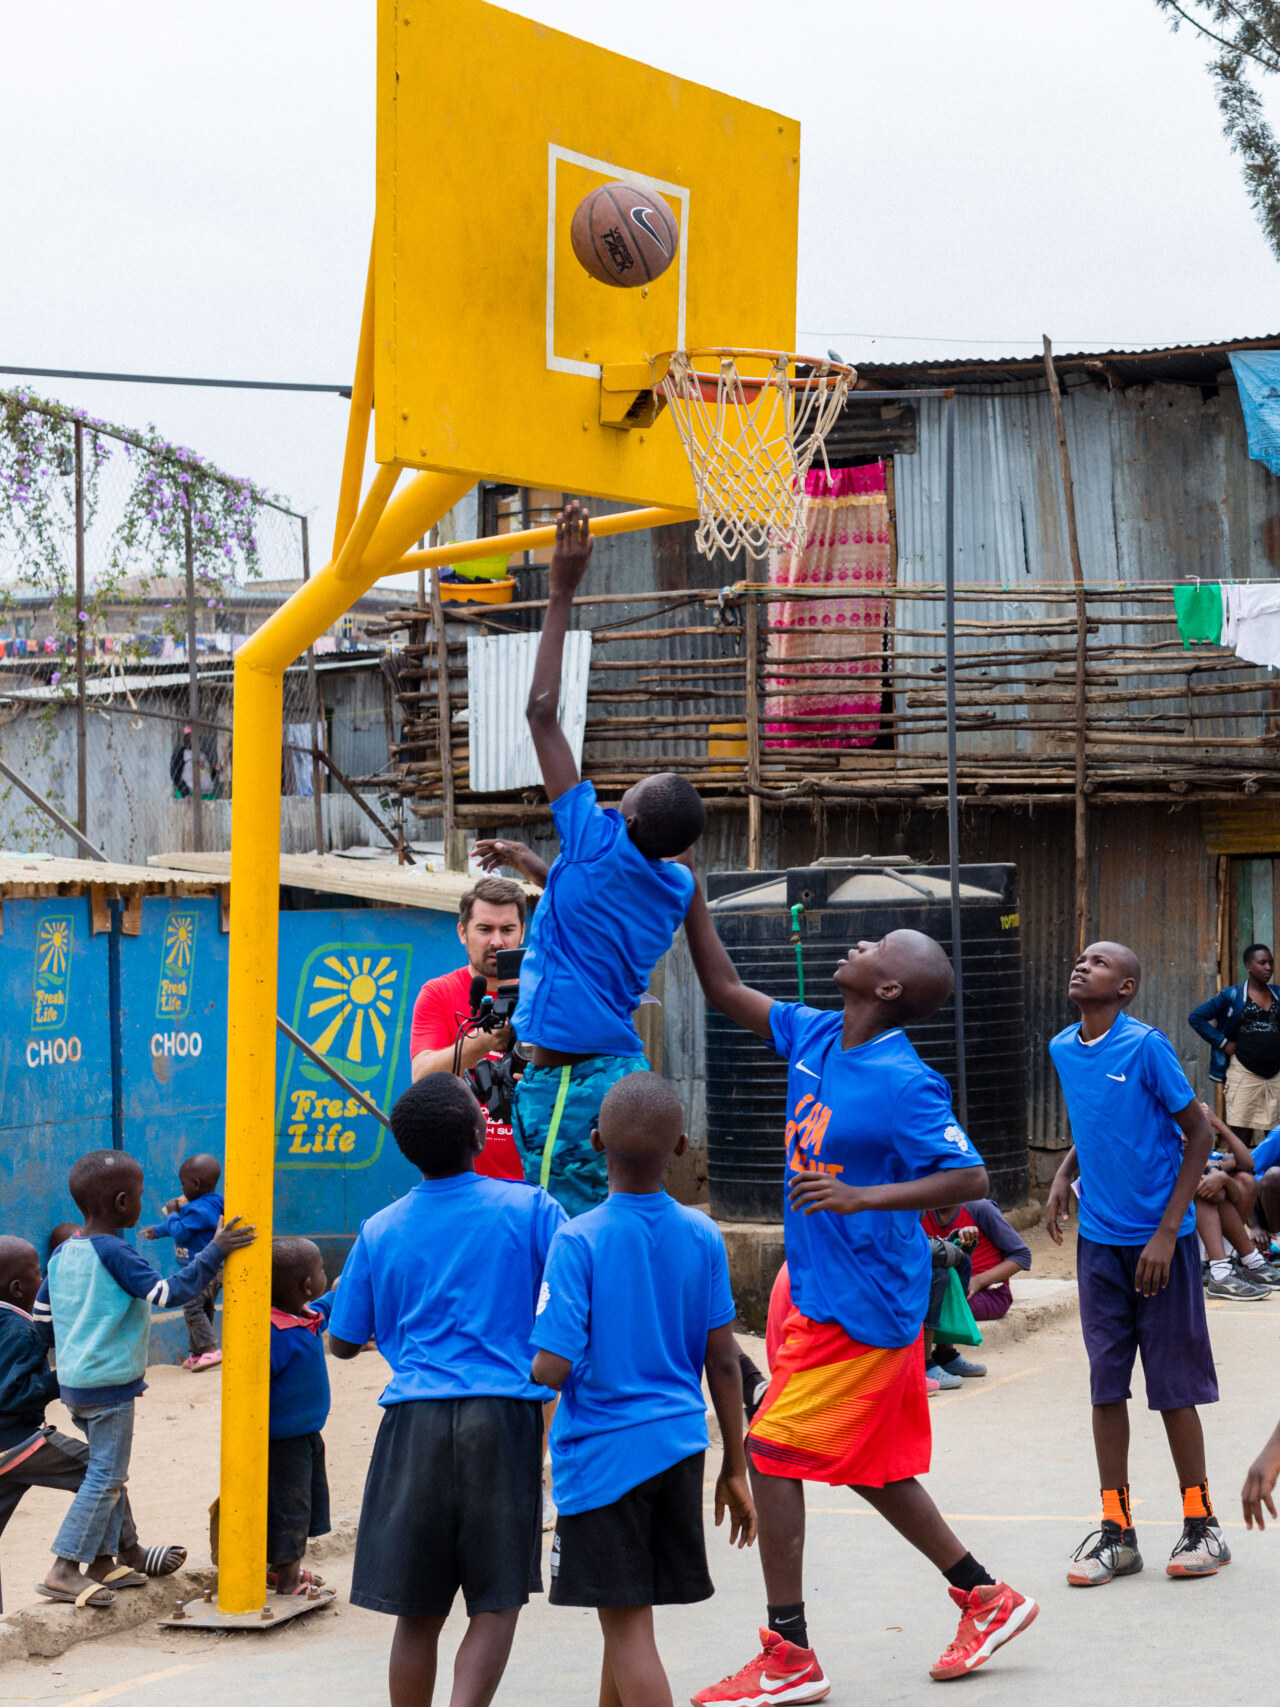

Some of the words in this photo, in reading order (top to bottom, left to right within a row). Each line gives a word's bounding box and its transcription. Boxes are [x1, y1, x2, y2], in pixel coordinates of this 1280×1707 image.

[600, 228, 633, 273] TACK
[611, 226, 634, 268] VERSA
[36, 990, 64, 1007] Fresh
[161, 979, 188, 996] Fresh
[35, 1006, 58, 1023] Life
[161, 996, 181, 1012] Life
[26, 1036, 82, 1068] CHOO
[151, 1032, 202, 1057] CHOO
[288, 1123, 356, 1154] Life
